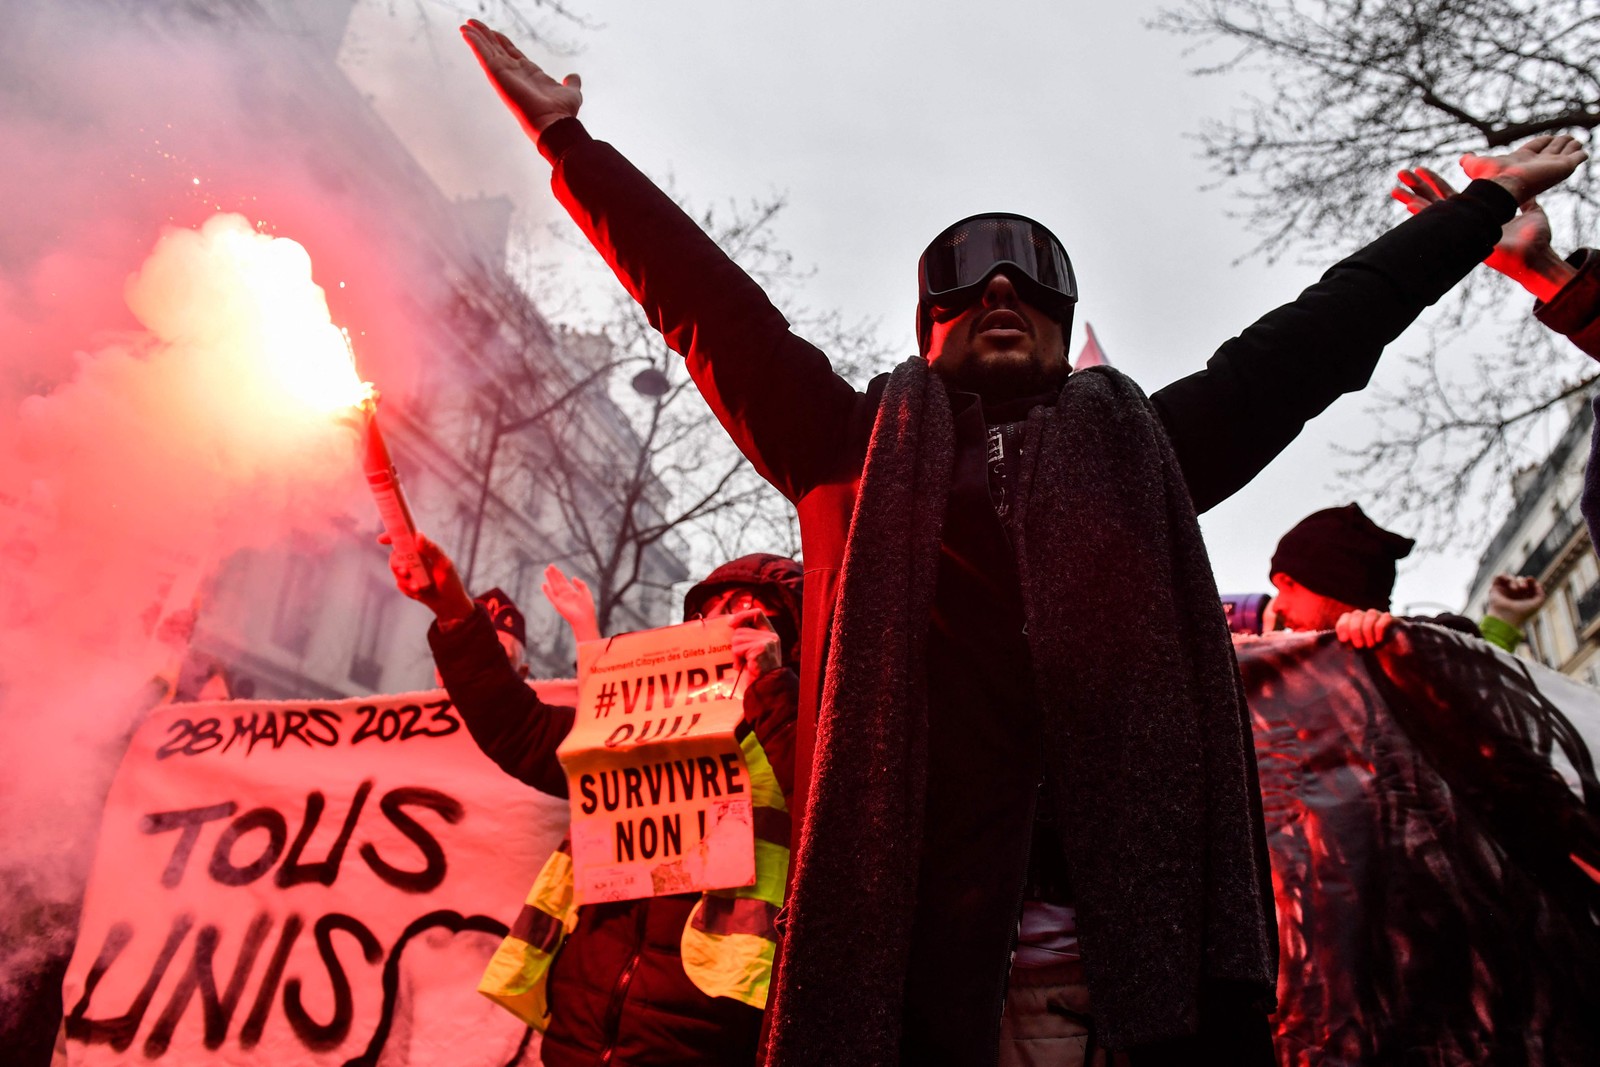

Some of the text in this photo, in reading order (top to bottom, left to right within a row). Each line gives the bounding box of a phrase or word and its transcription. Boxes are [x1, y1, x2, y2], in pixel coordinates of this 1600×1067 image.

[635, 655, 666, 668] Citoyen
[667, 653, 681, 662] des
[683, 647, 706, 659] Gilets
[708, 642, 733, 655] Jaune
[595, 662, 734, 719] #VIVRE
[155, 699, 462, 760] 28 MARS 2023
[580, 752, 745, 815] SURVIVRE
[141, 777, 465, 893] TOUS
[615, 813, 682, 863] NON
[64, 911, 385, 1060] UNIS
